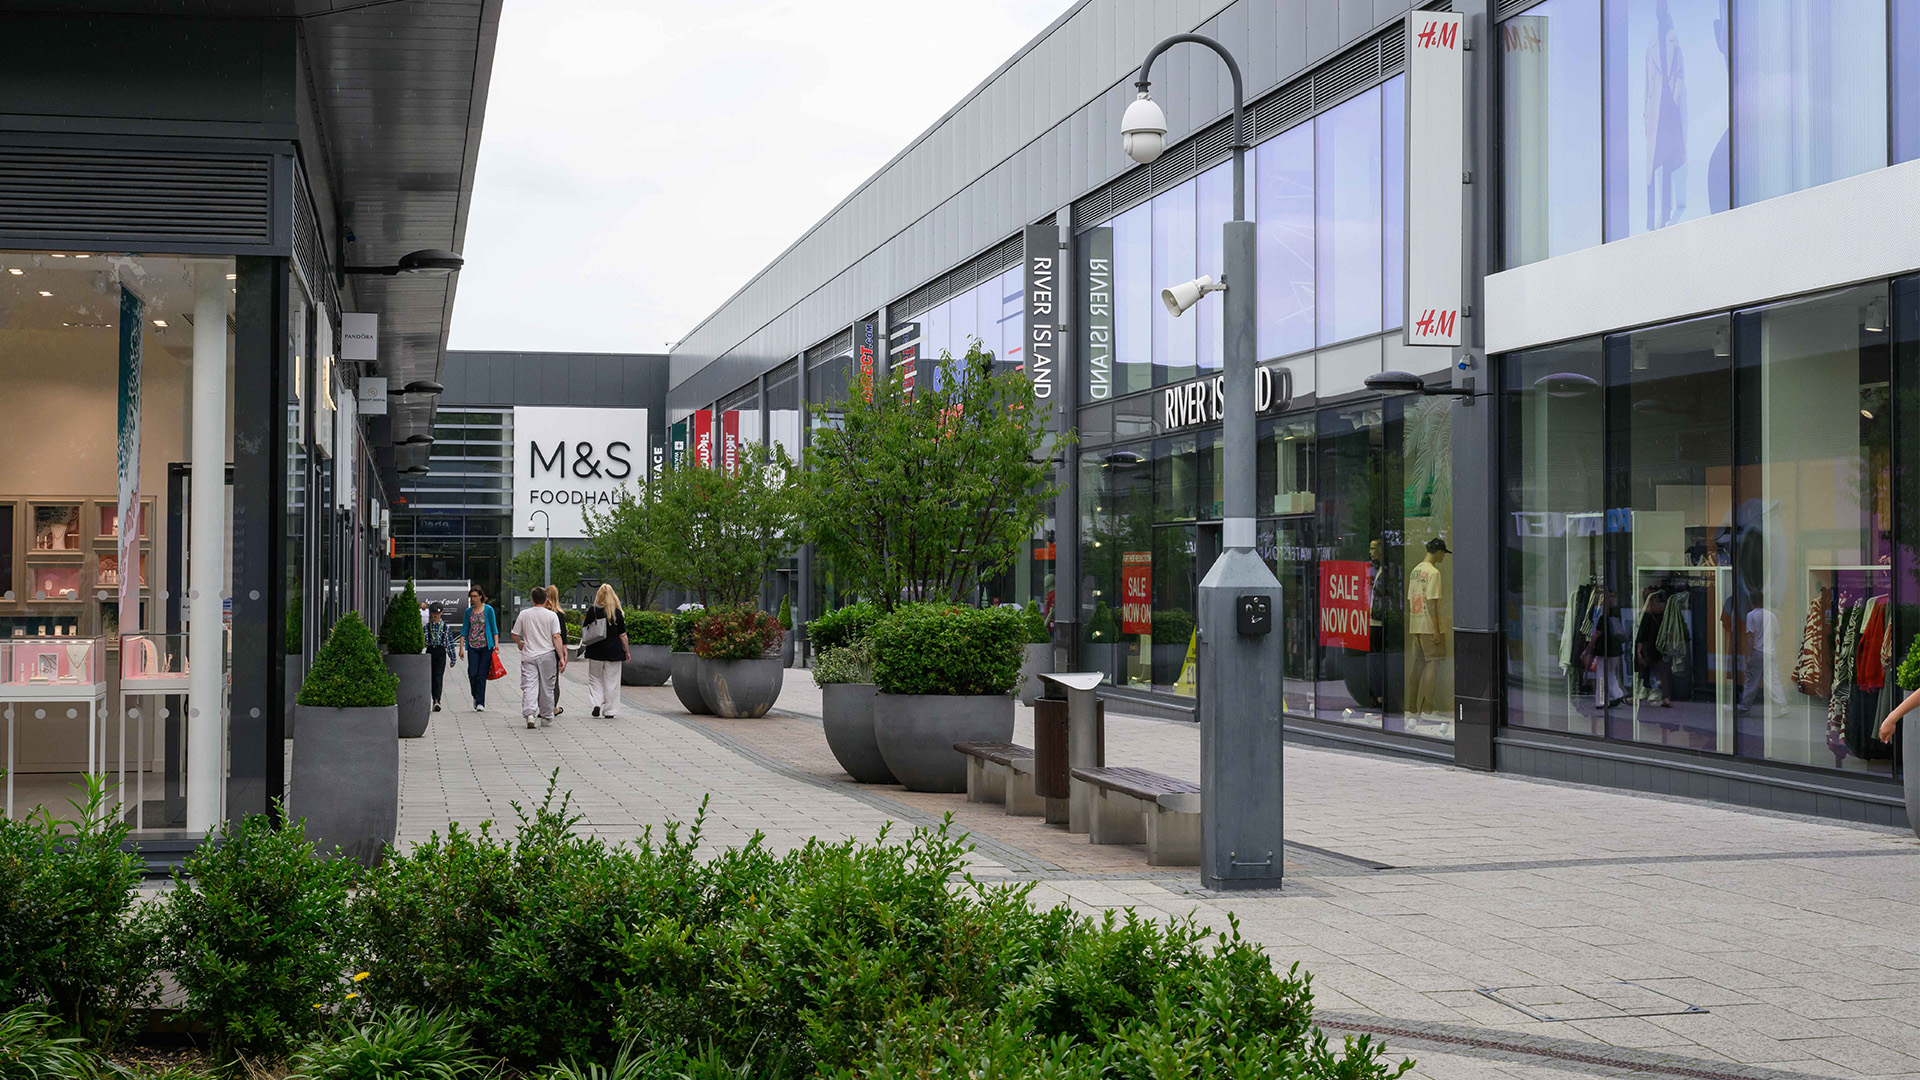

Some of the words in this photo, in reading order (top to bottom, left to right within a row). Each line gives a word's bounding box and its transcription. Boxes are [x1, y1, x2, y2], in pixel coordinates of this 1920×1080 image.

[1418, 21, 1458, 50] H&M
[1033, 257, 1052, 315] RIVER
[1415, 308, 1457, 339] H&M
[1033, 324, 1052, 399] ISLAND
[1165, 381, 1207, 429] RIVER
[530, 440, 632, 479] M&S
[1128, 577, 1147, 597] SALE
[1329, 574, 1359, 600] SALE
[1123, 603, 1139, 623] NOW
[1140, 603, 1152, 624] ON
[1321, 607, 1348, 634] NOW
[1350, 609, 1368, 636] ON
